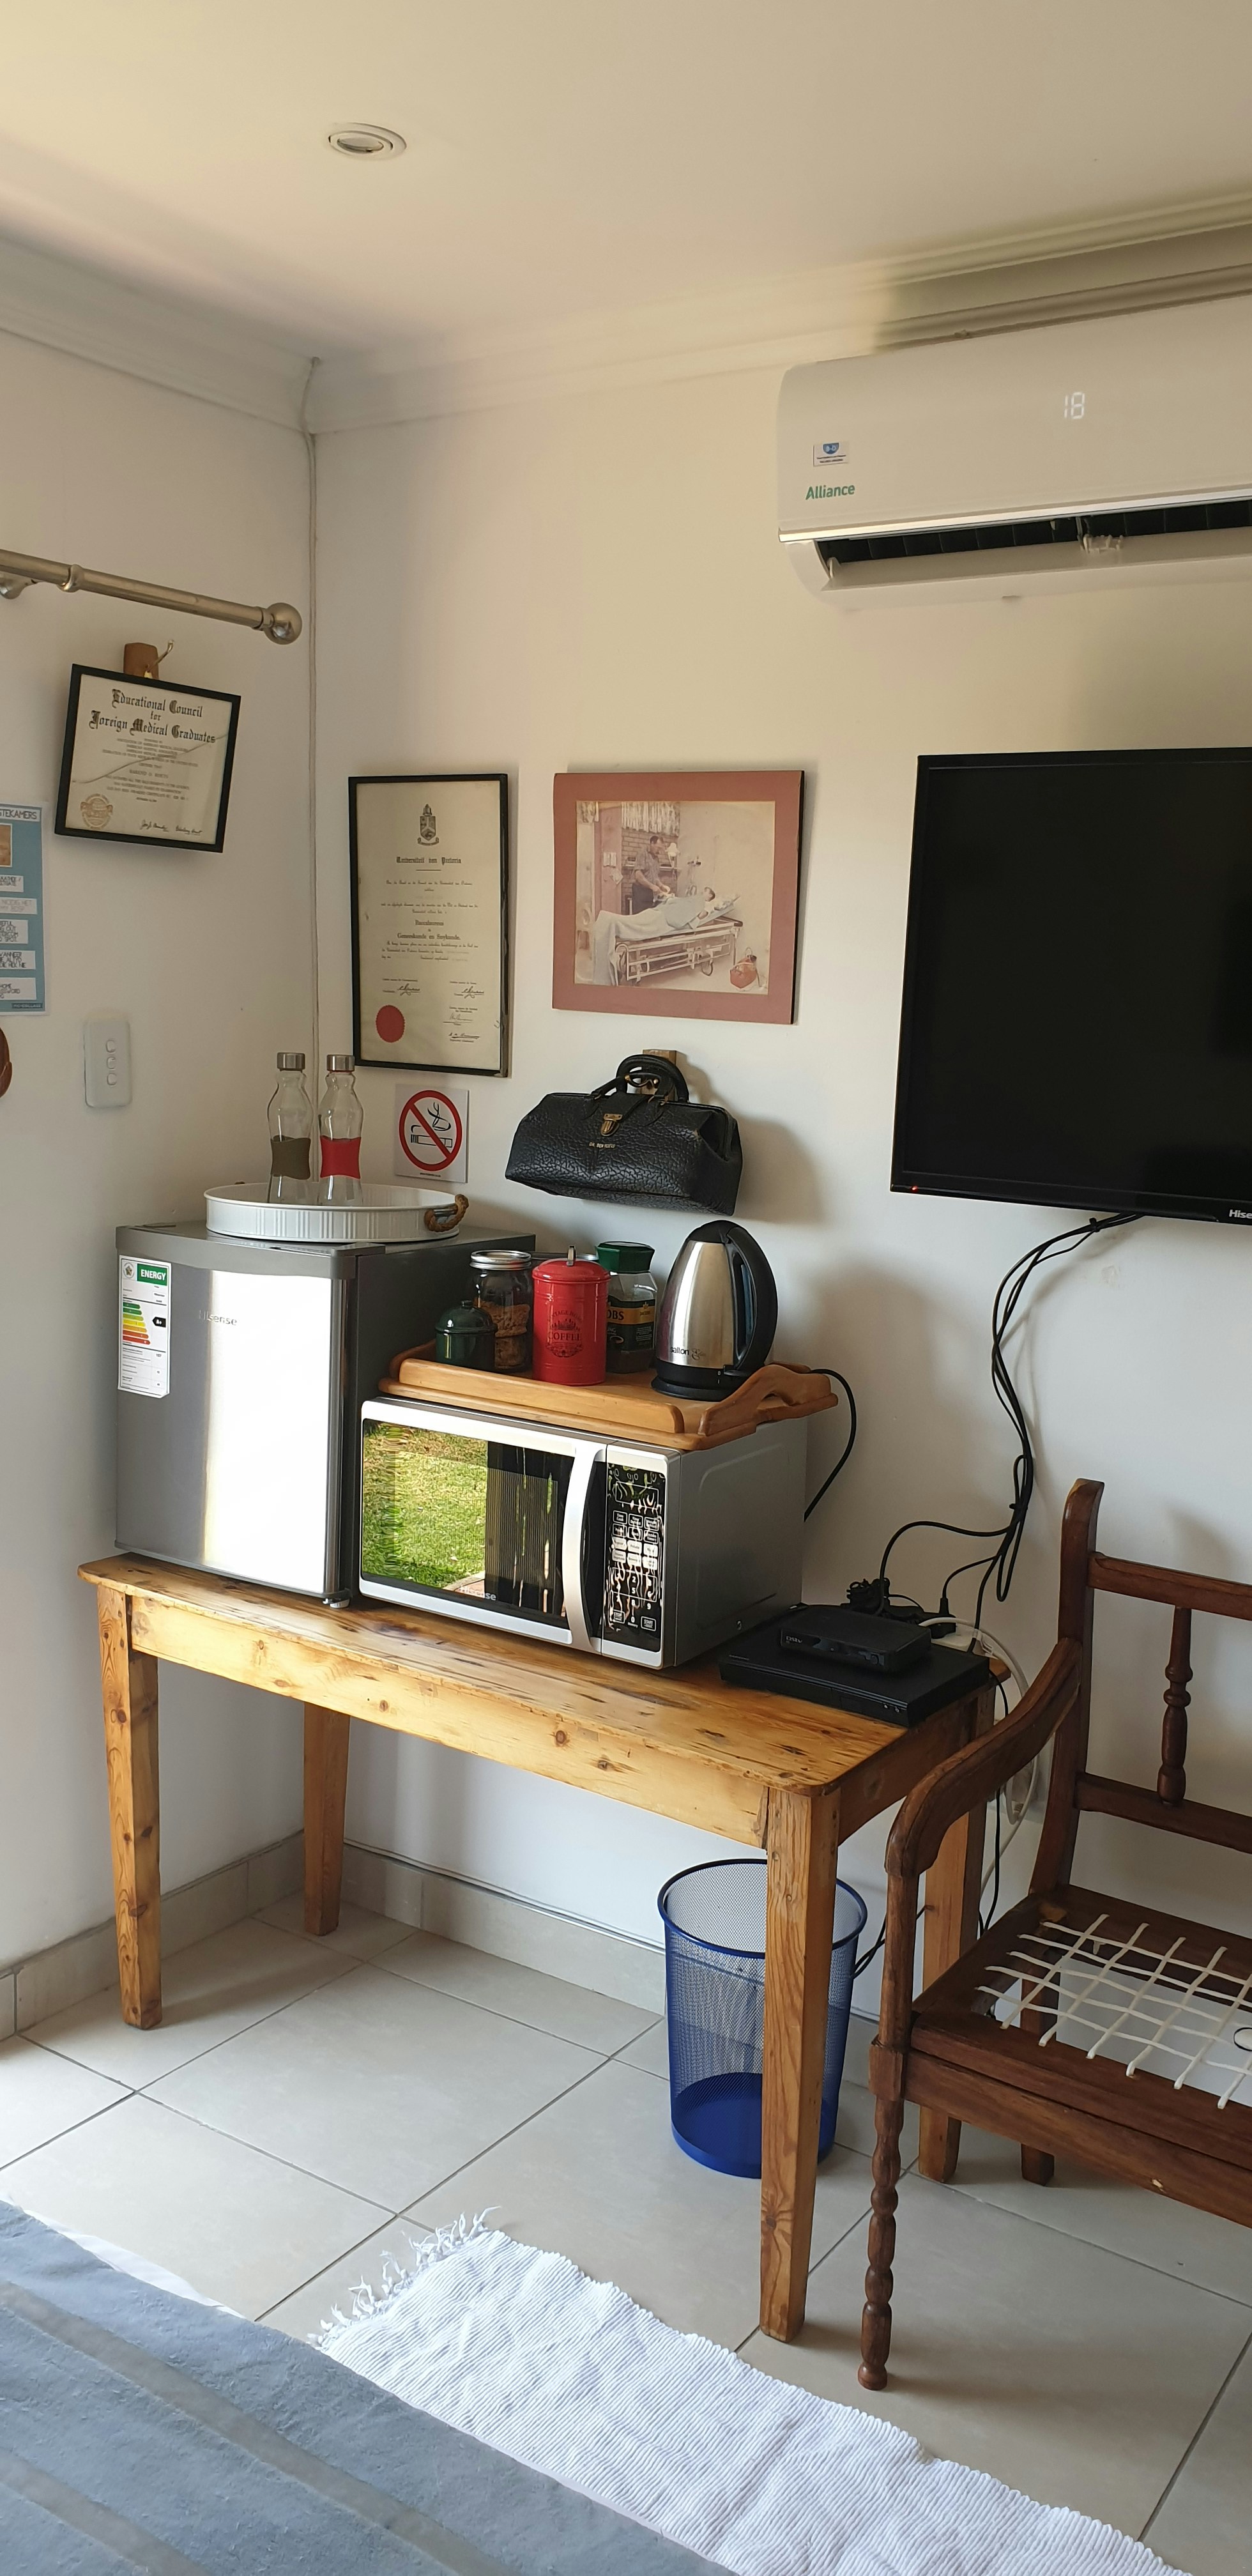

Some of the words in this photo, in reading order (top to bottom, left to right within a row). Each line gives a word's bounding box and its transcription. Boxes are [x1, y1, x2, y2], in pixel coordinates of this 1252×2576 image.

[1064, 392, 1085, 419] 18
[805, 485, 855, 500] Alliance
[112, 689, 166, 709] Educational
[169, 700, 203, 717] Council
[150, 710, 161, 721] for
[89, 710, 127, 732] Foreign
[129, 718, 168, 736] Medical
[171, 724, 216, 743] Graduates
[1229, 1209, 1252, 1219] Hise
[141, 1269, 166, 1280] ENERGY
